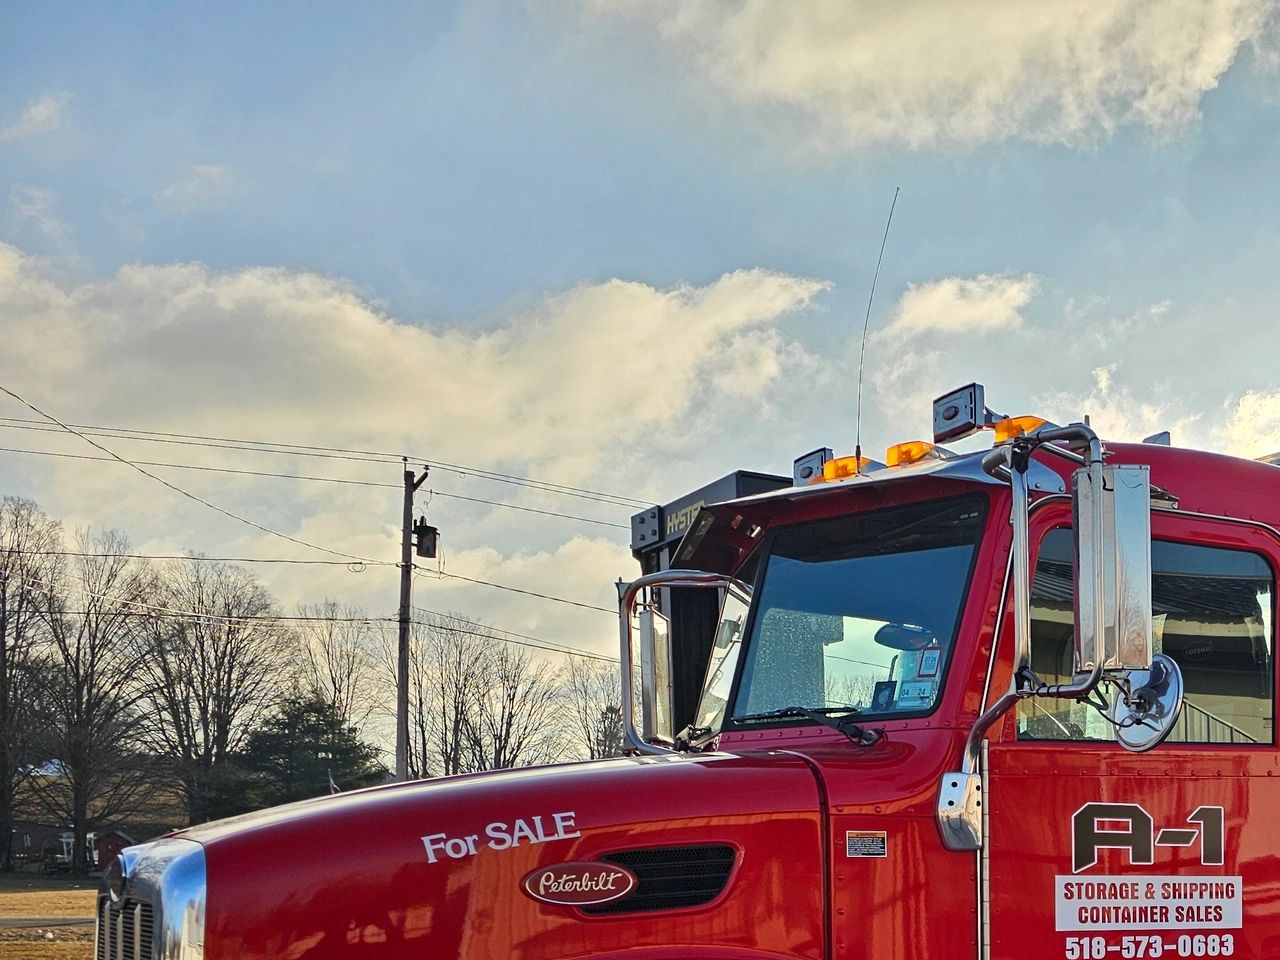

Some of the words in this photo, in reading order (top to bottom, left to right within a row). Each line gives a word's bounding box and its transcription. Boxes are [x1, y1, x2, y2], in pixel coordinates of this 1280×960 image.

[667, 500, 705, 534] HYSTE
[421, 833, 478, 864] For
[485, 811, 581, 850] SALE
[1071, 802, 1225, 873] A-1
[539, 871, 623, 896] Peterbilt
[1063, 881, 1140, 900] STORAGE
[1144, 882, 1156, 899] &
[1161, 881, 1236, 900] SHIPPING
[1077, 905, 1170, 924] CONTAINER
[1175, 905, 1223, 923] SALES
[1065, 933, 1235, 960] 518-573-0683
